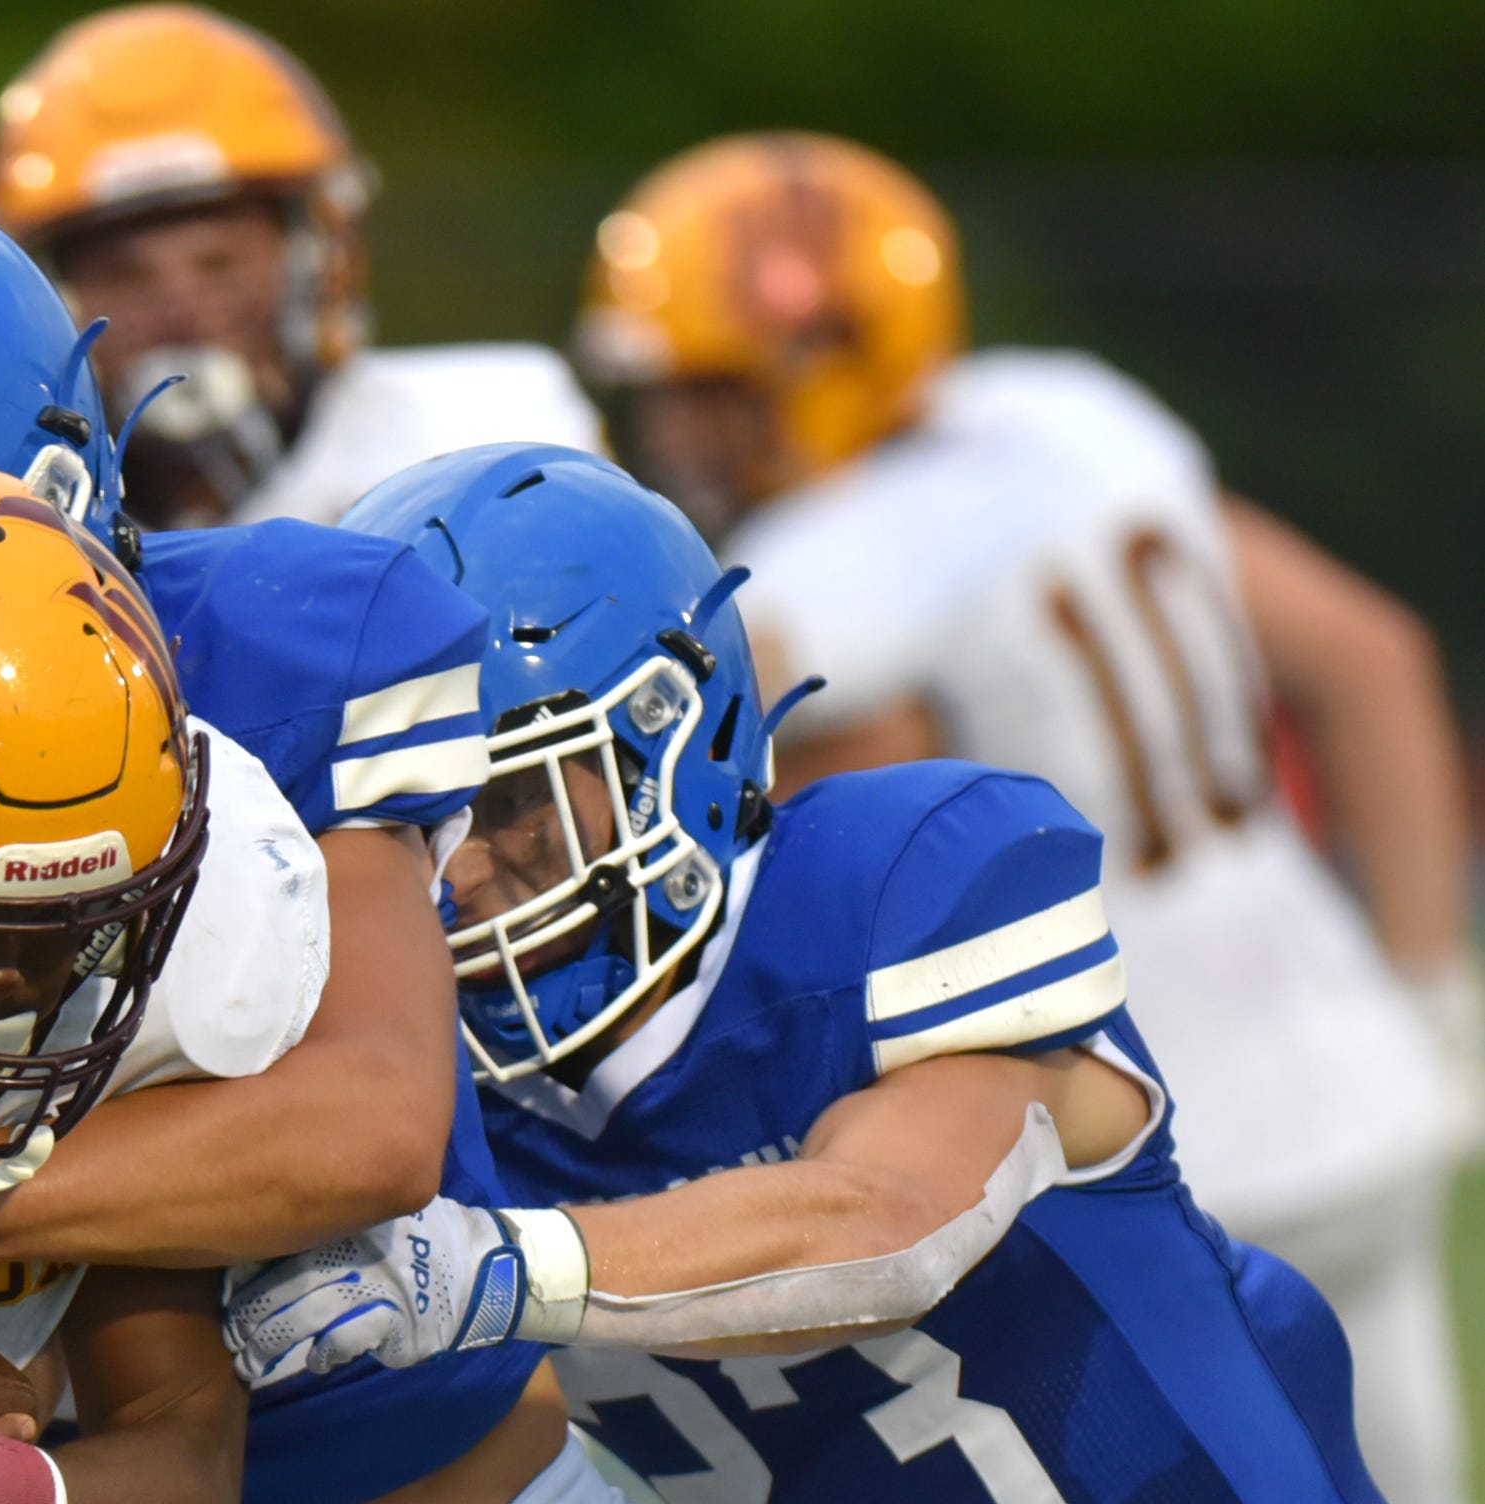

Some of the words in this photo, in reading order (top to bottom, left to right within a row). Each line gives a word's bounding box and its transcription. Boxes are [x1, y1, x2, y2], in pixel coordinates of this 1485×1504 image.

[628, 777, 660, 838] dell
[4, 847, 117, 883] Riddell
[404, 1210, 430, 1315] adid
